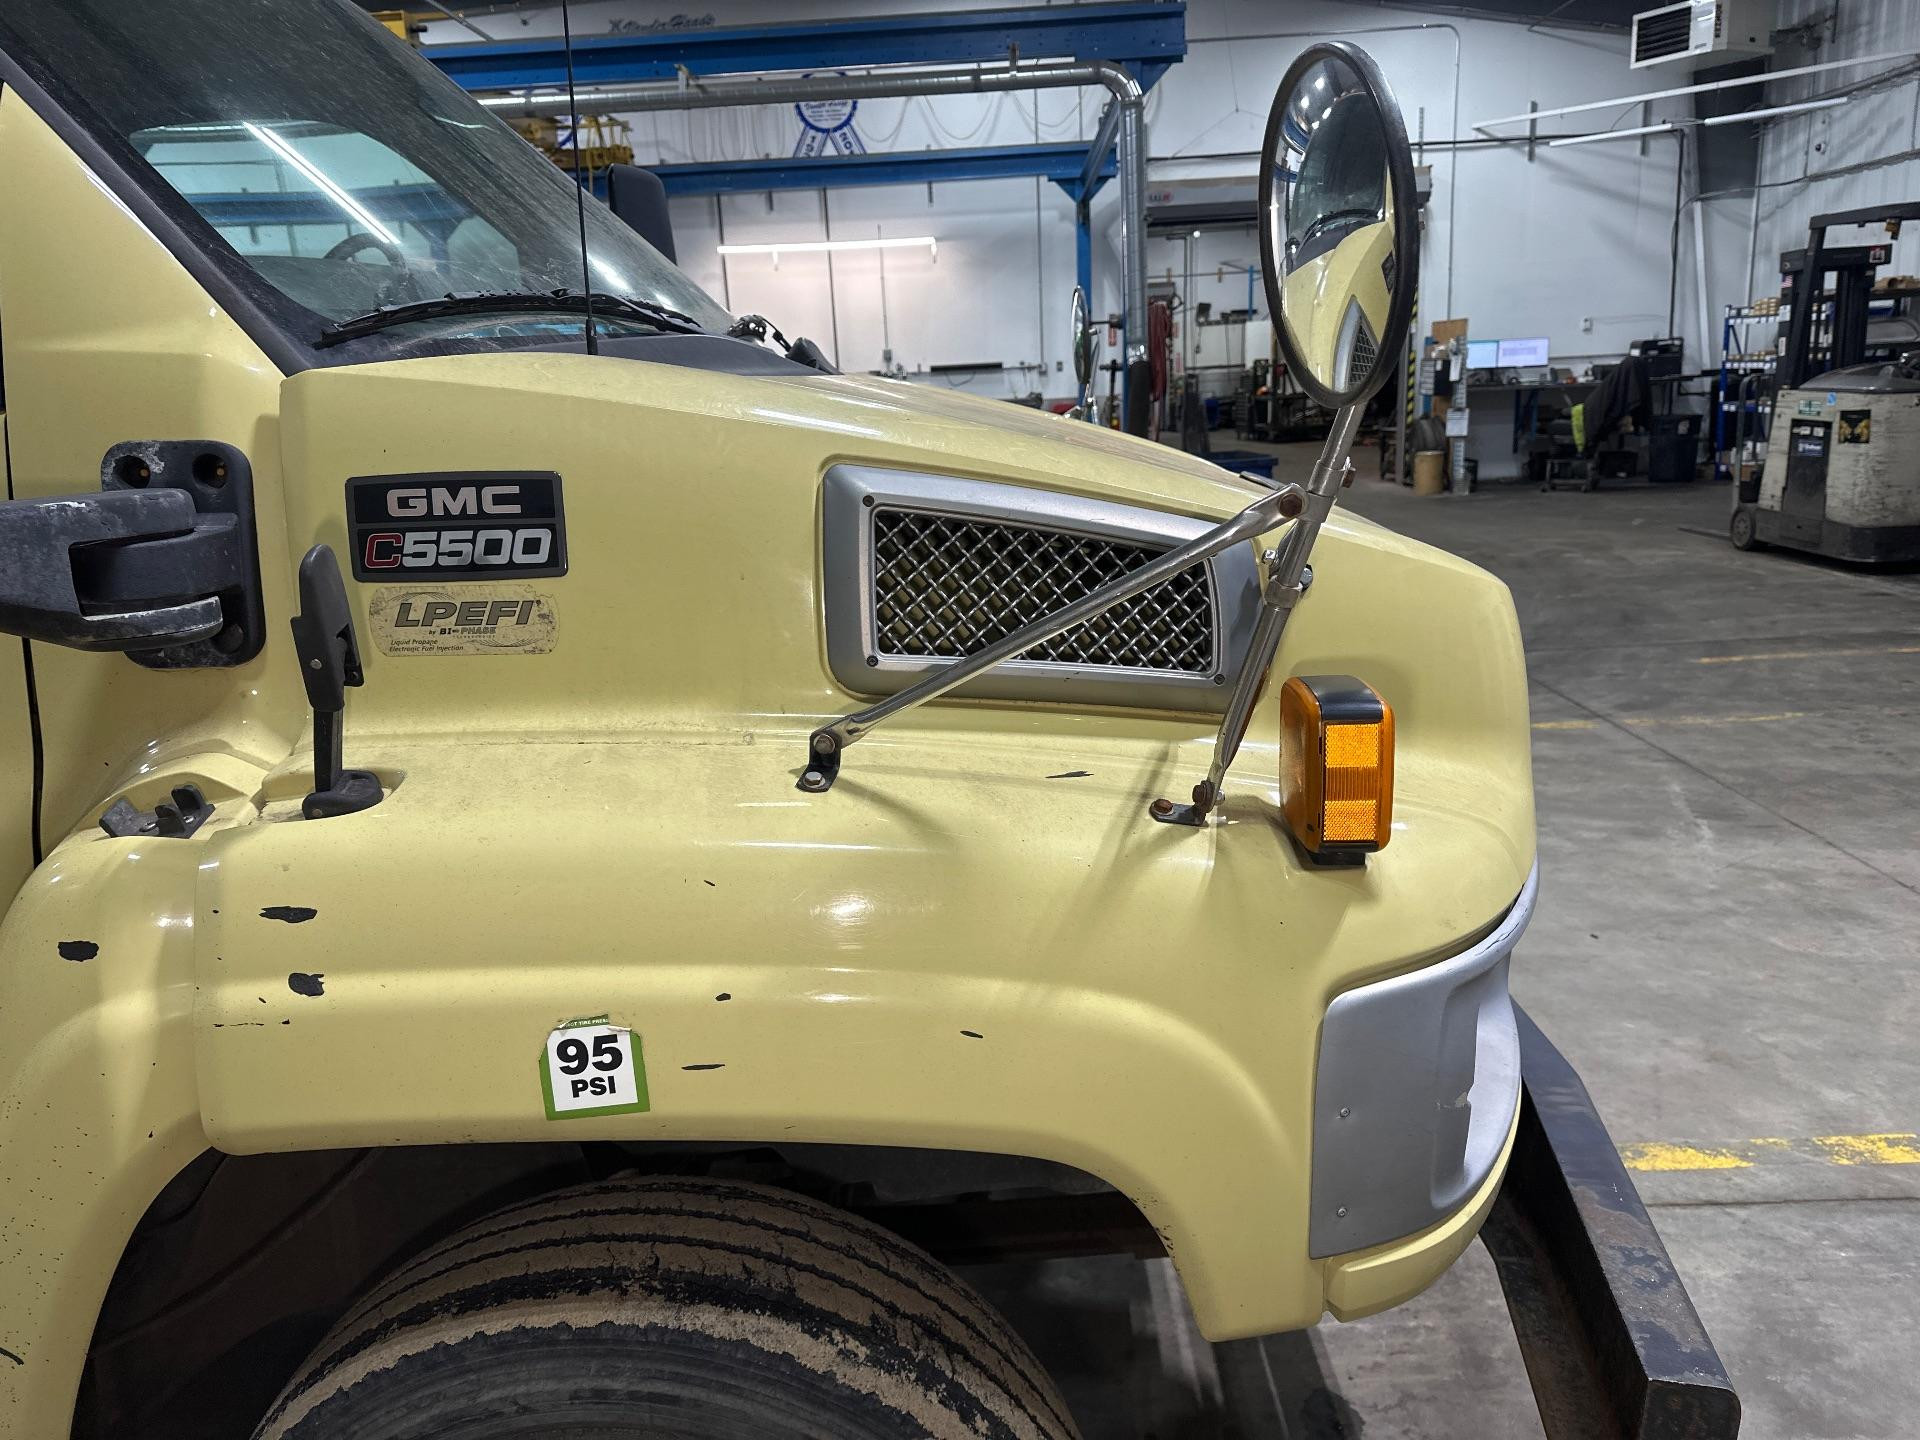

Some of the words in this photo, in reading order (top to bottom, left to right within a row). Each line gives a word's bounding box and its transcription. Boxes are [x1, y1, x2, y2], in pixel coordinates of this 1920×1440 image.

[387, 486, 521, 517] GMC
[365, 528, 551, 568] C5500
[395, 600, 534, 627] LPEFI
[556, 1034, 623, 1075] 95
[571, 1076, 616, 1098] PSI
